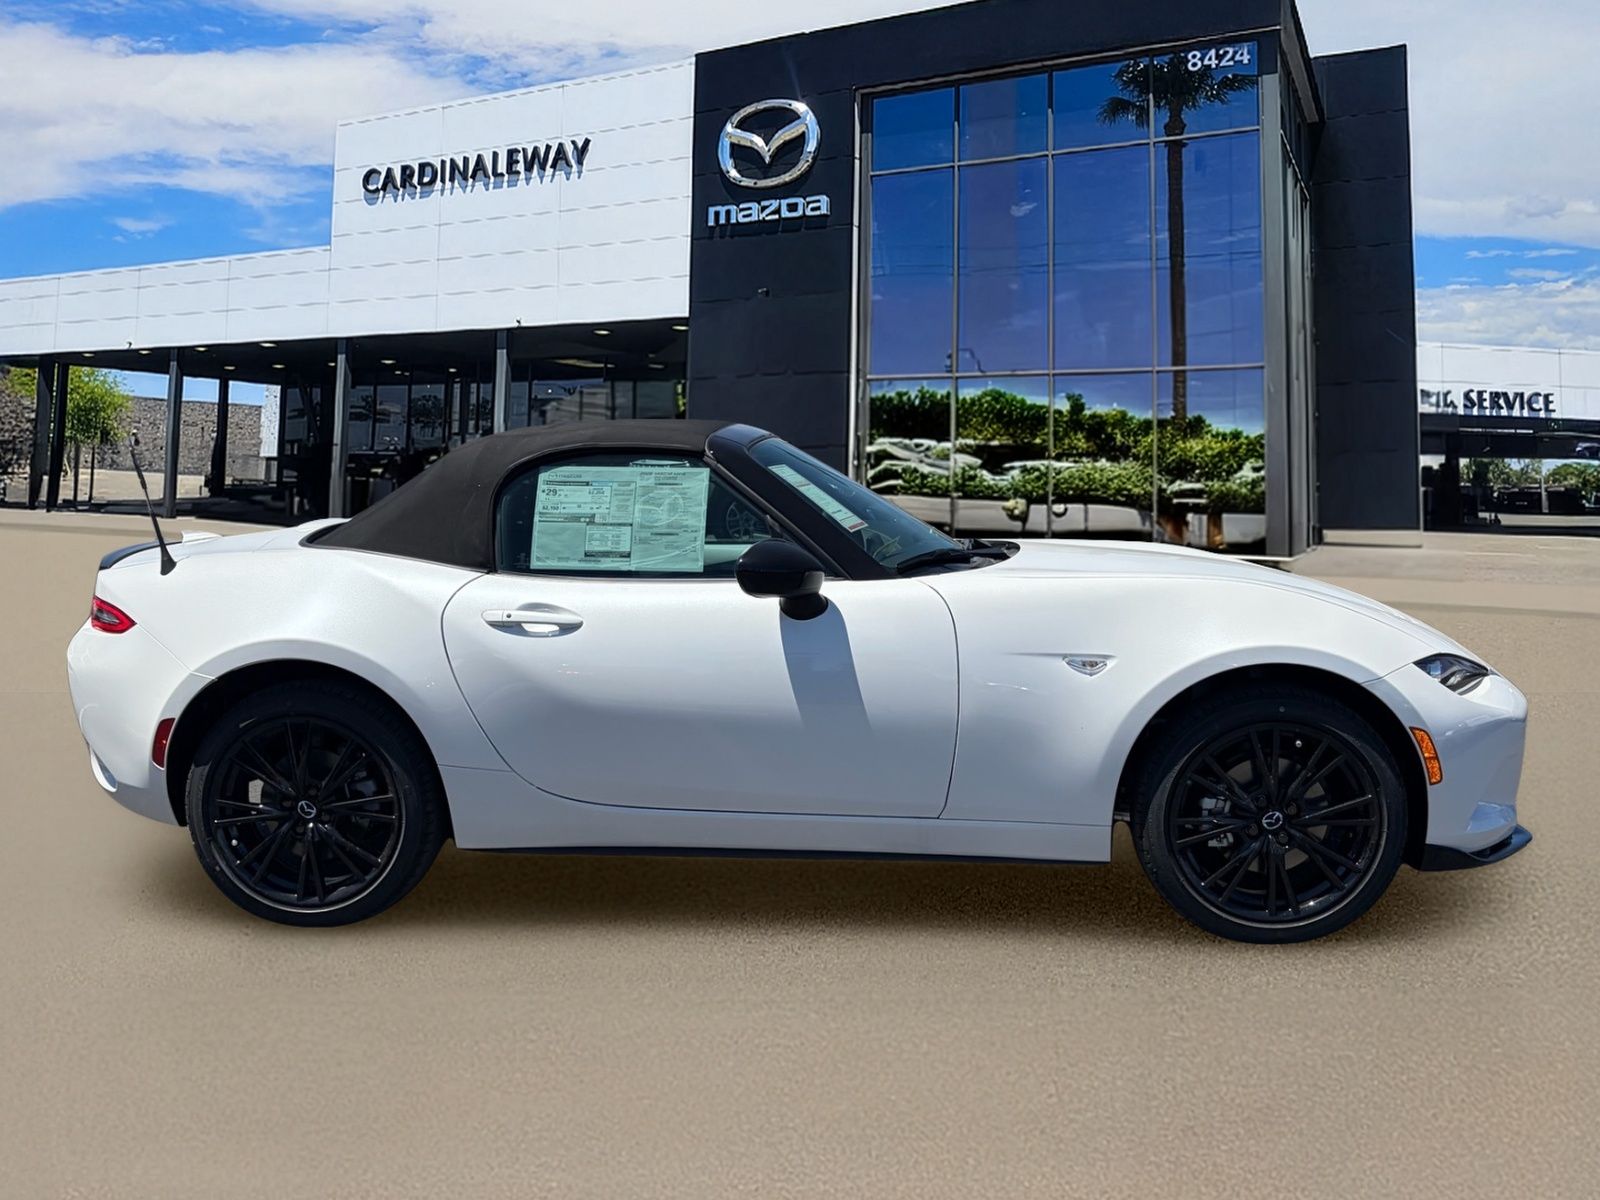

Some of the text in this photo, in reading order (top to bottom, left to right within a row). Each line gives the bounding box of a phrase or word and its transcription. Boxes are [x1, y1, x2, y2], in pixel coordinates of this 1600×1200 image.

[1187, 45, 1251, 71] 8424
[362, 138, 591, 195] CARDINALEWAY
[707, 194, 830, 227] mazda
[1463, 389, 1556, 413] SERVICE
